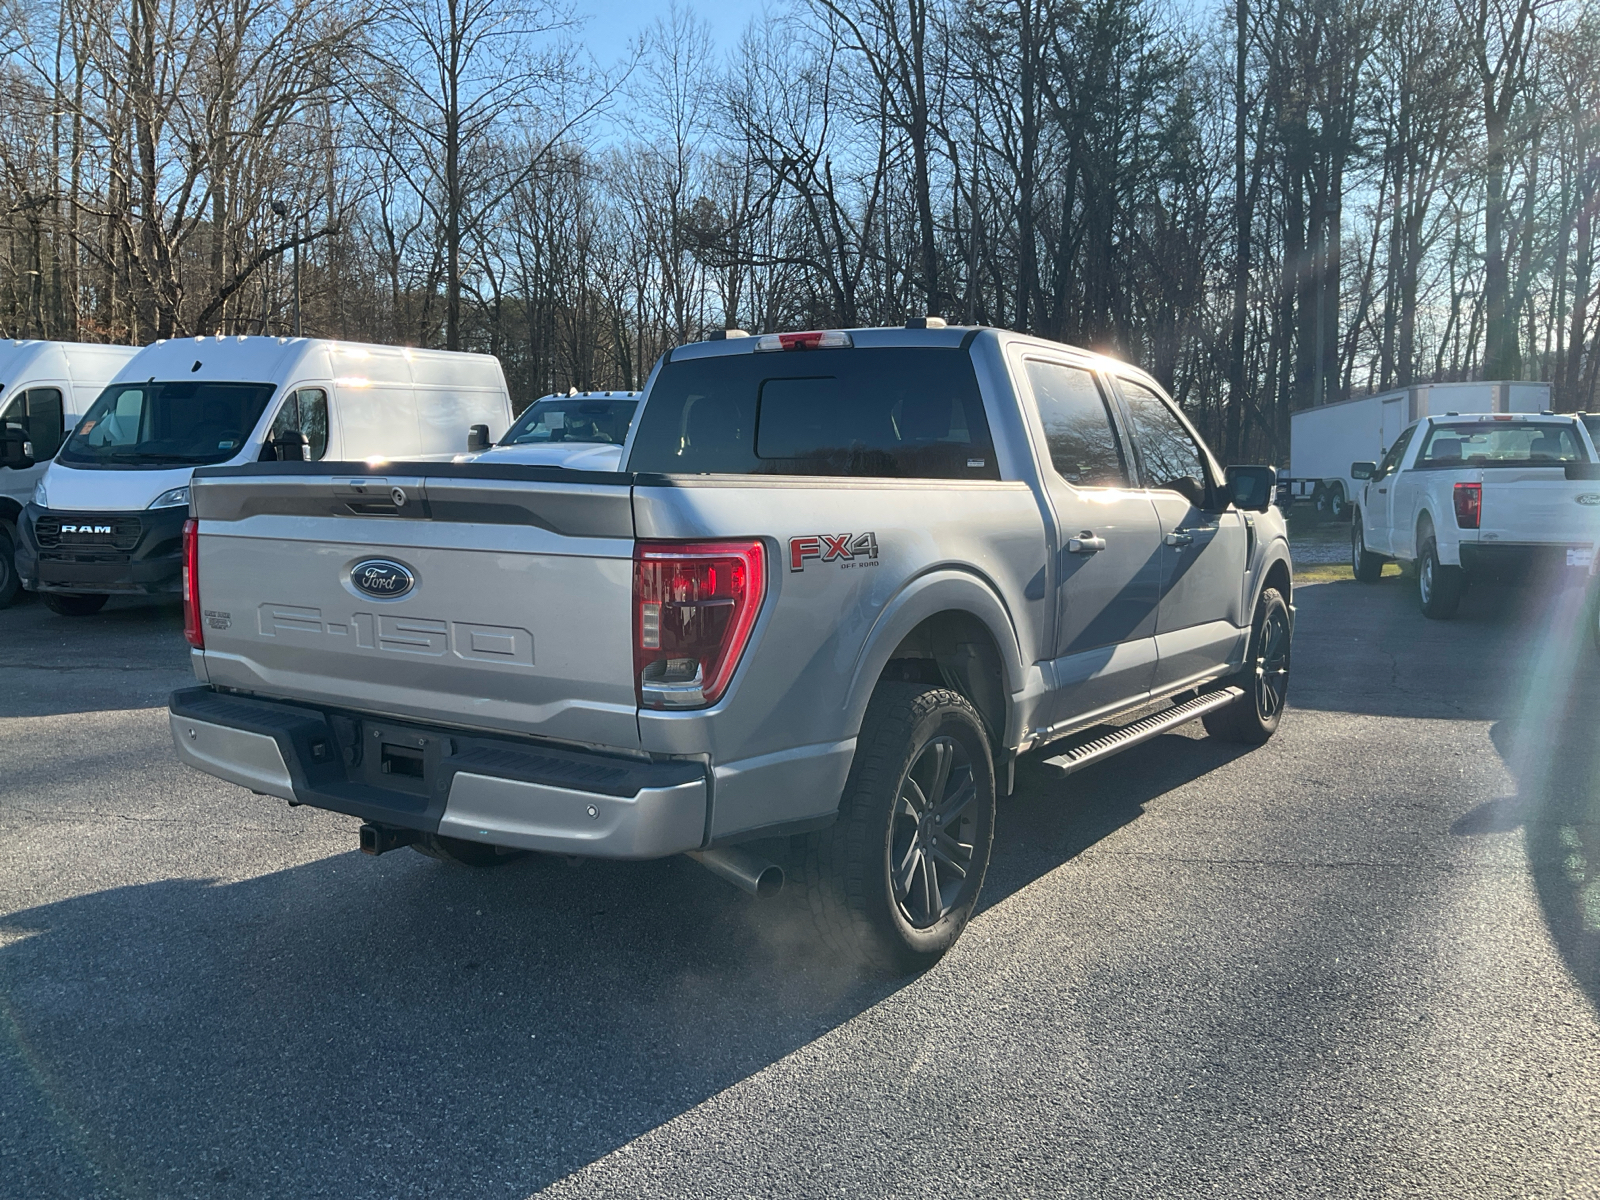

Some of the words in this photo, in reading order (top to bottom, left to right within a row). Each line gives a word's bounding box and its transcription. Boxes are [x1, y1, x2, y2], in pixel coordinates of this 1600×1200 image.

[61, 525, 111, 534] RAM
[788, 532, 879, 573] FX4
[362, 567, 396, 590] Ford
[258, 602, 535, 668] F-150
